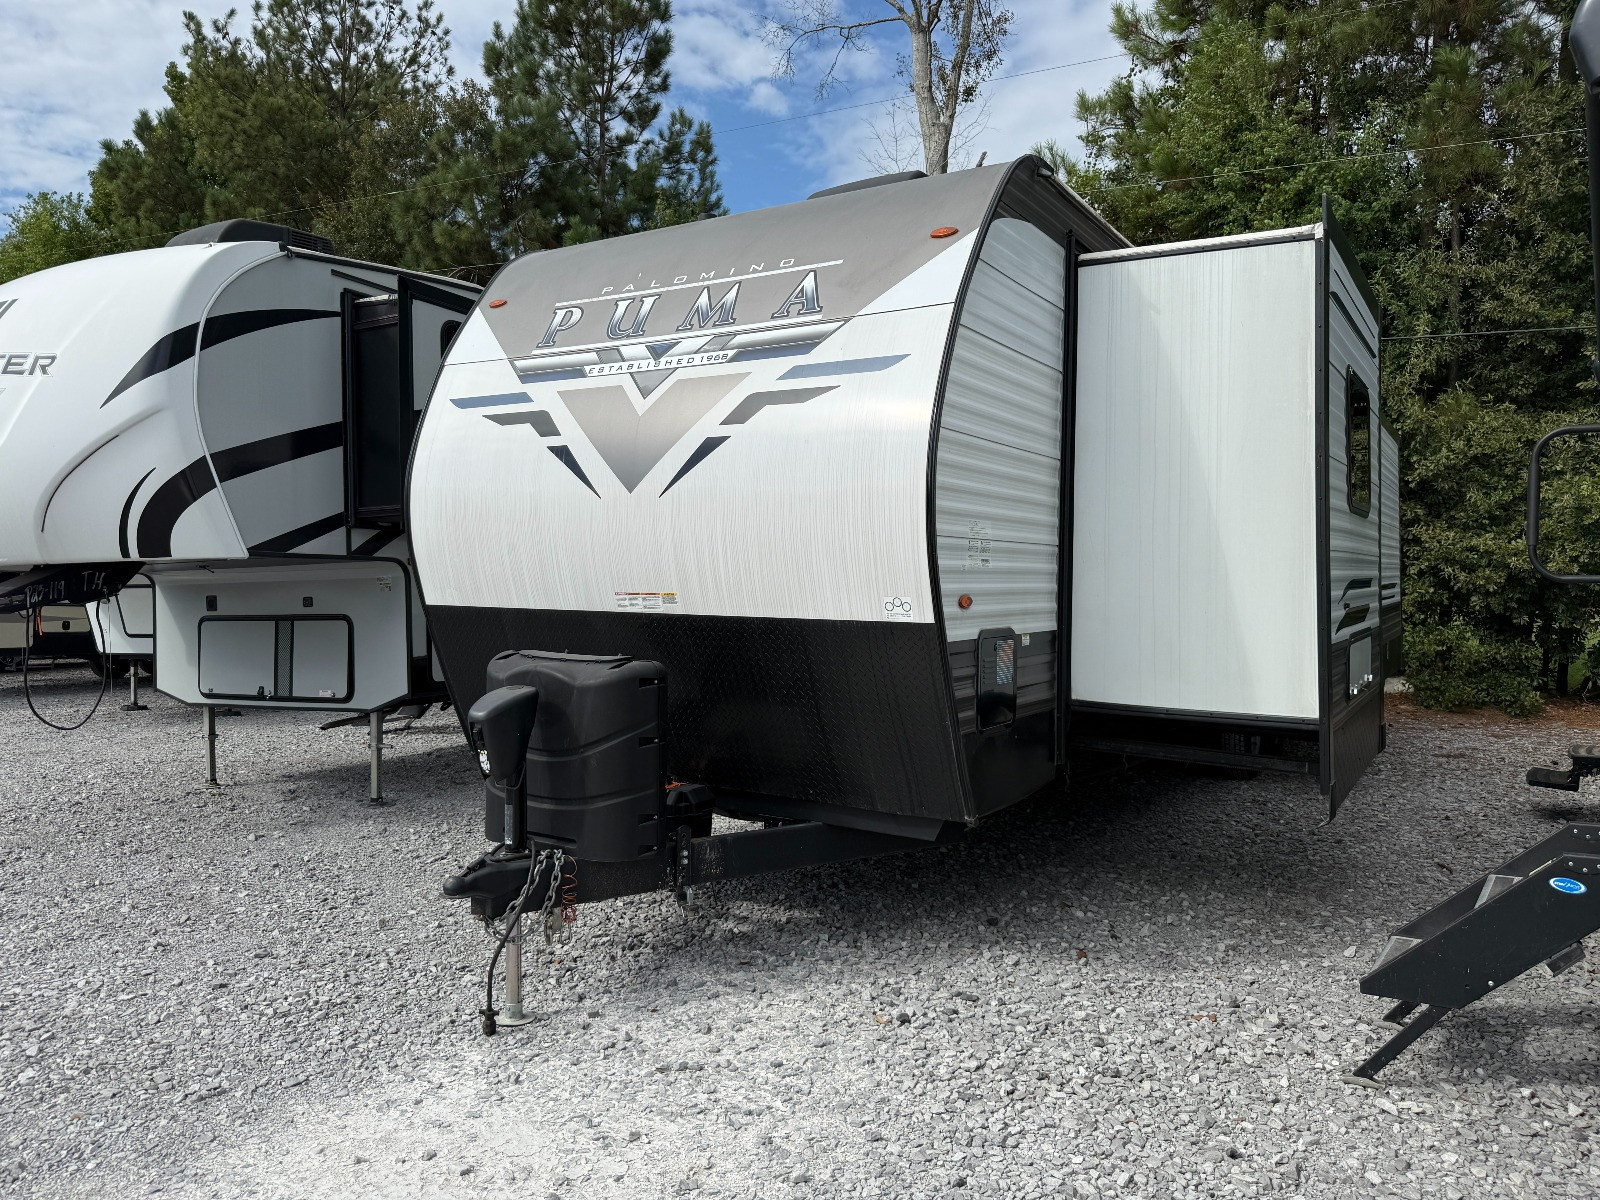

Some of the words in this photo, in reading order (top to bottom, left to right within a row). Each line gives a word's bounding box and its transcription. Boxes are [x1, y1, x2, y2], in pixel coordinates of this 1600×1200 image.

[601, 258, 795, 294] PALOMINO
[536, 269, 824, 348] PUMA
[588, 357, 695, 375] ESTABLISHED
[700, 353, 729, 364] 1968
